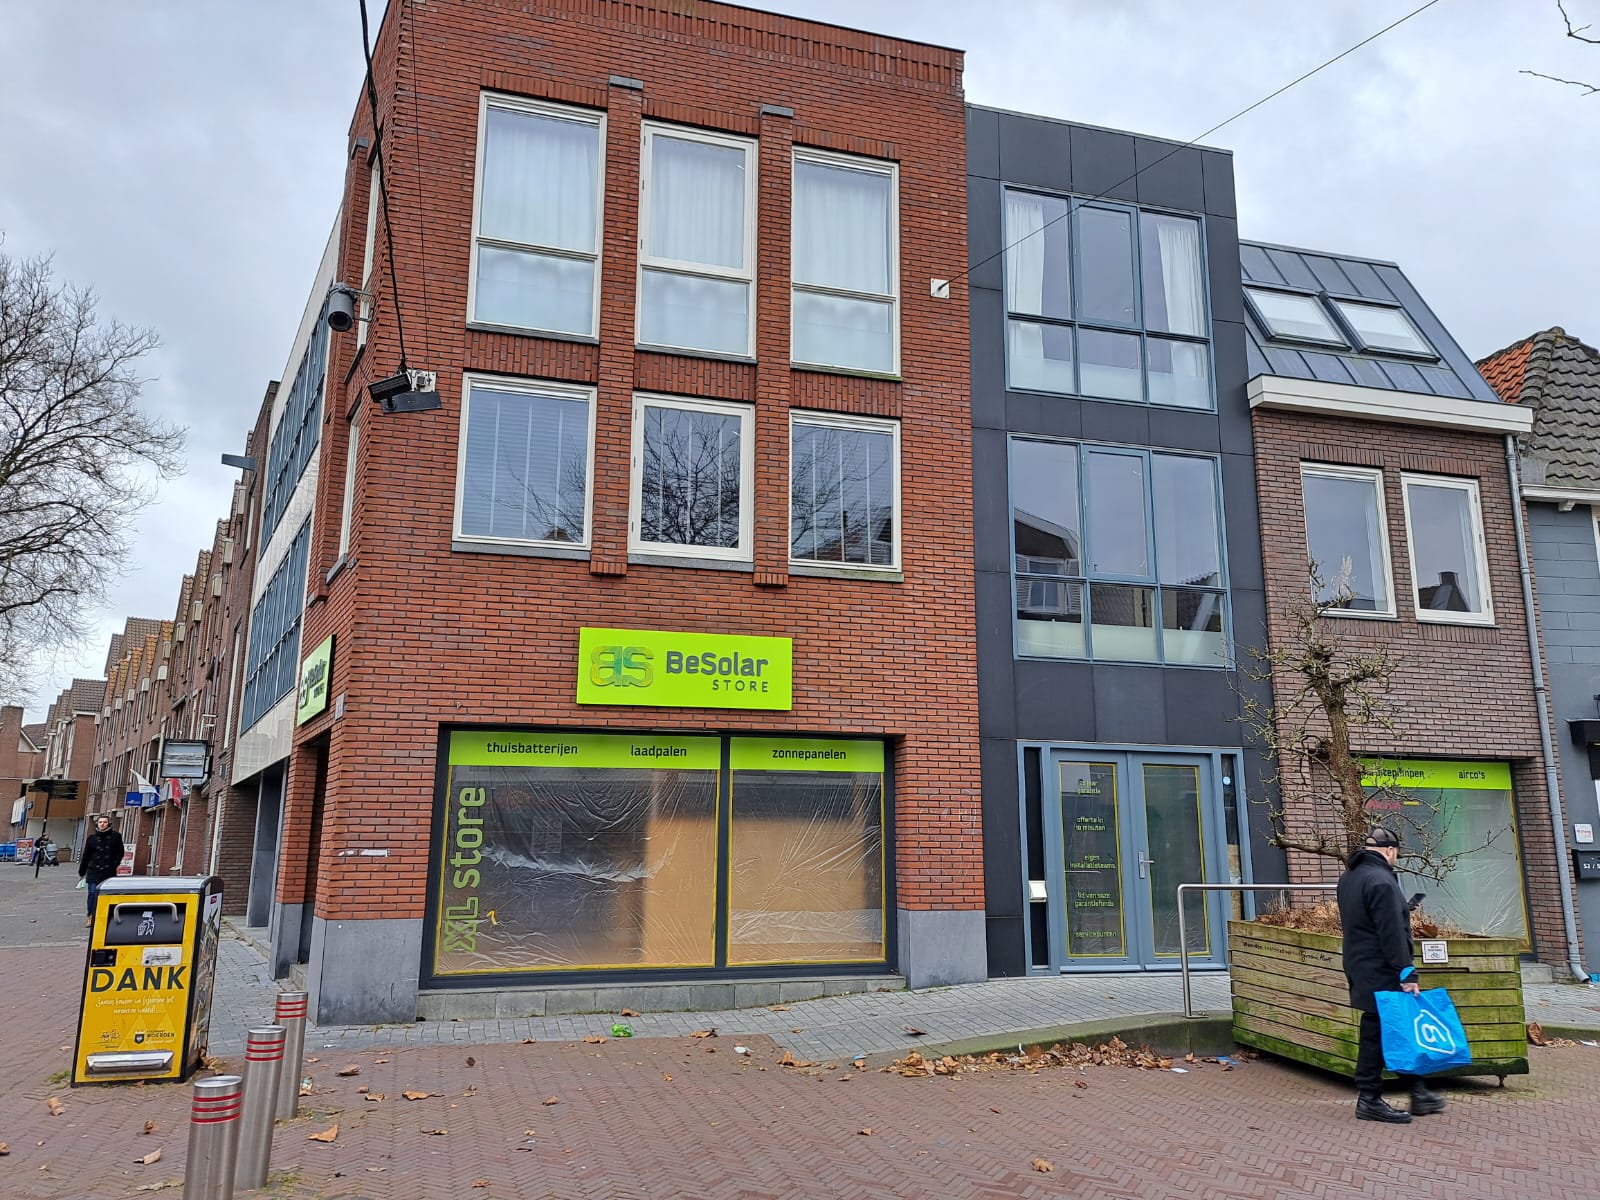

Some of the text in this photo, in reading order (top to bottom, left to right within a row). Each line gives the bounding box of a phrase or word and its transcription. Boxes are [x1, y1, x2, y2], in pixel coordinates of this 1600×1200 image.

[665, 650, 769, 678] BeSolar
[712, 679, 769, 692] STORE
[486, 742, 847, 761] thuisbatterijen laadpalen zonnepanelen
[1458, 770, 1486, 780] airco's
[443, 786, 487, 953] XL store
[91, 966, 186, 992] DANK
